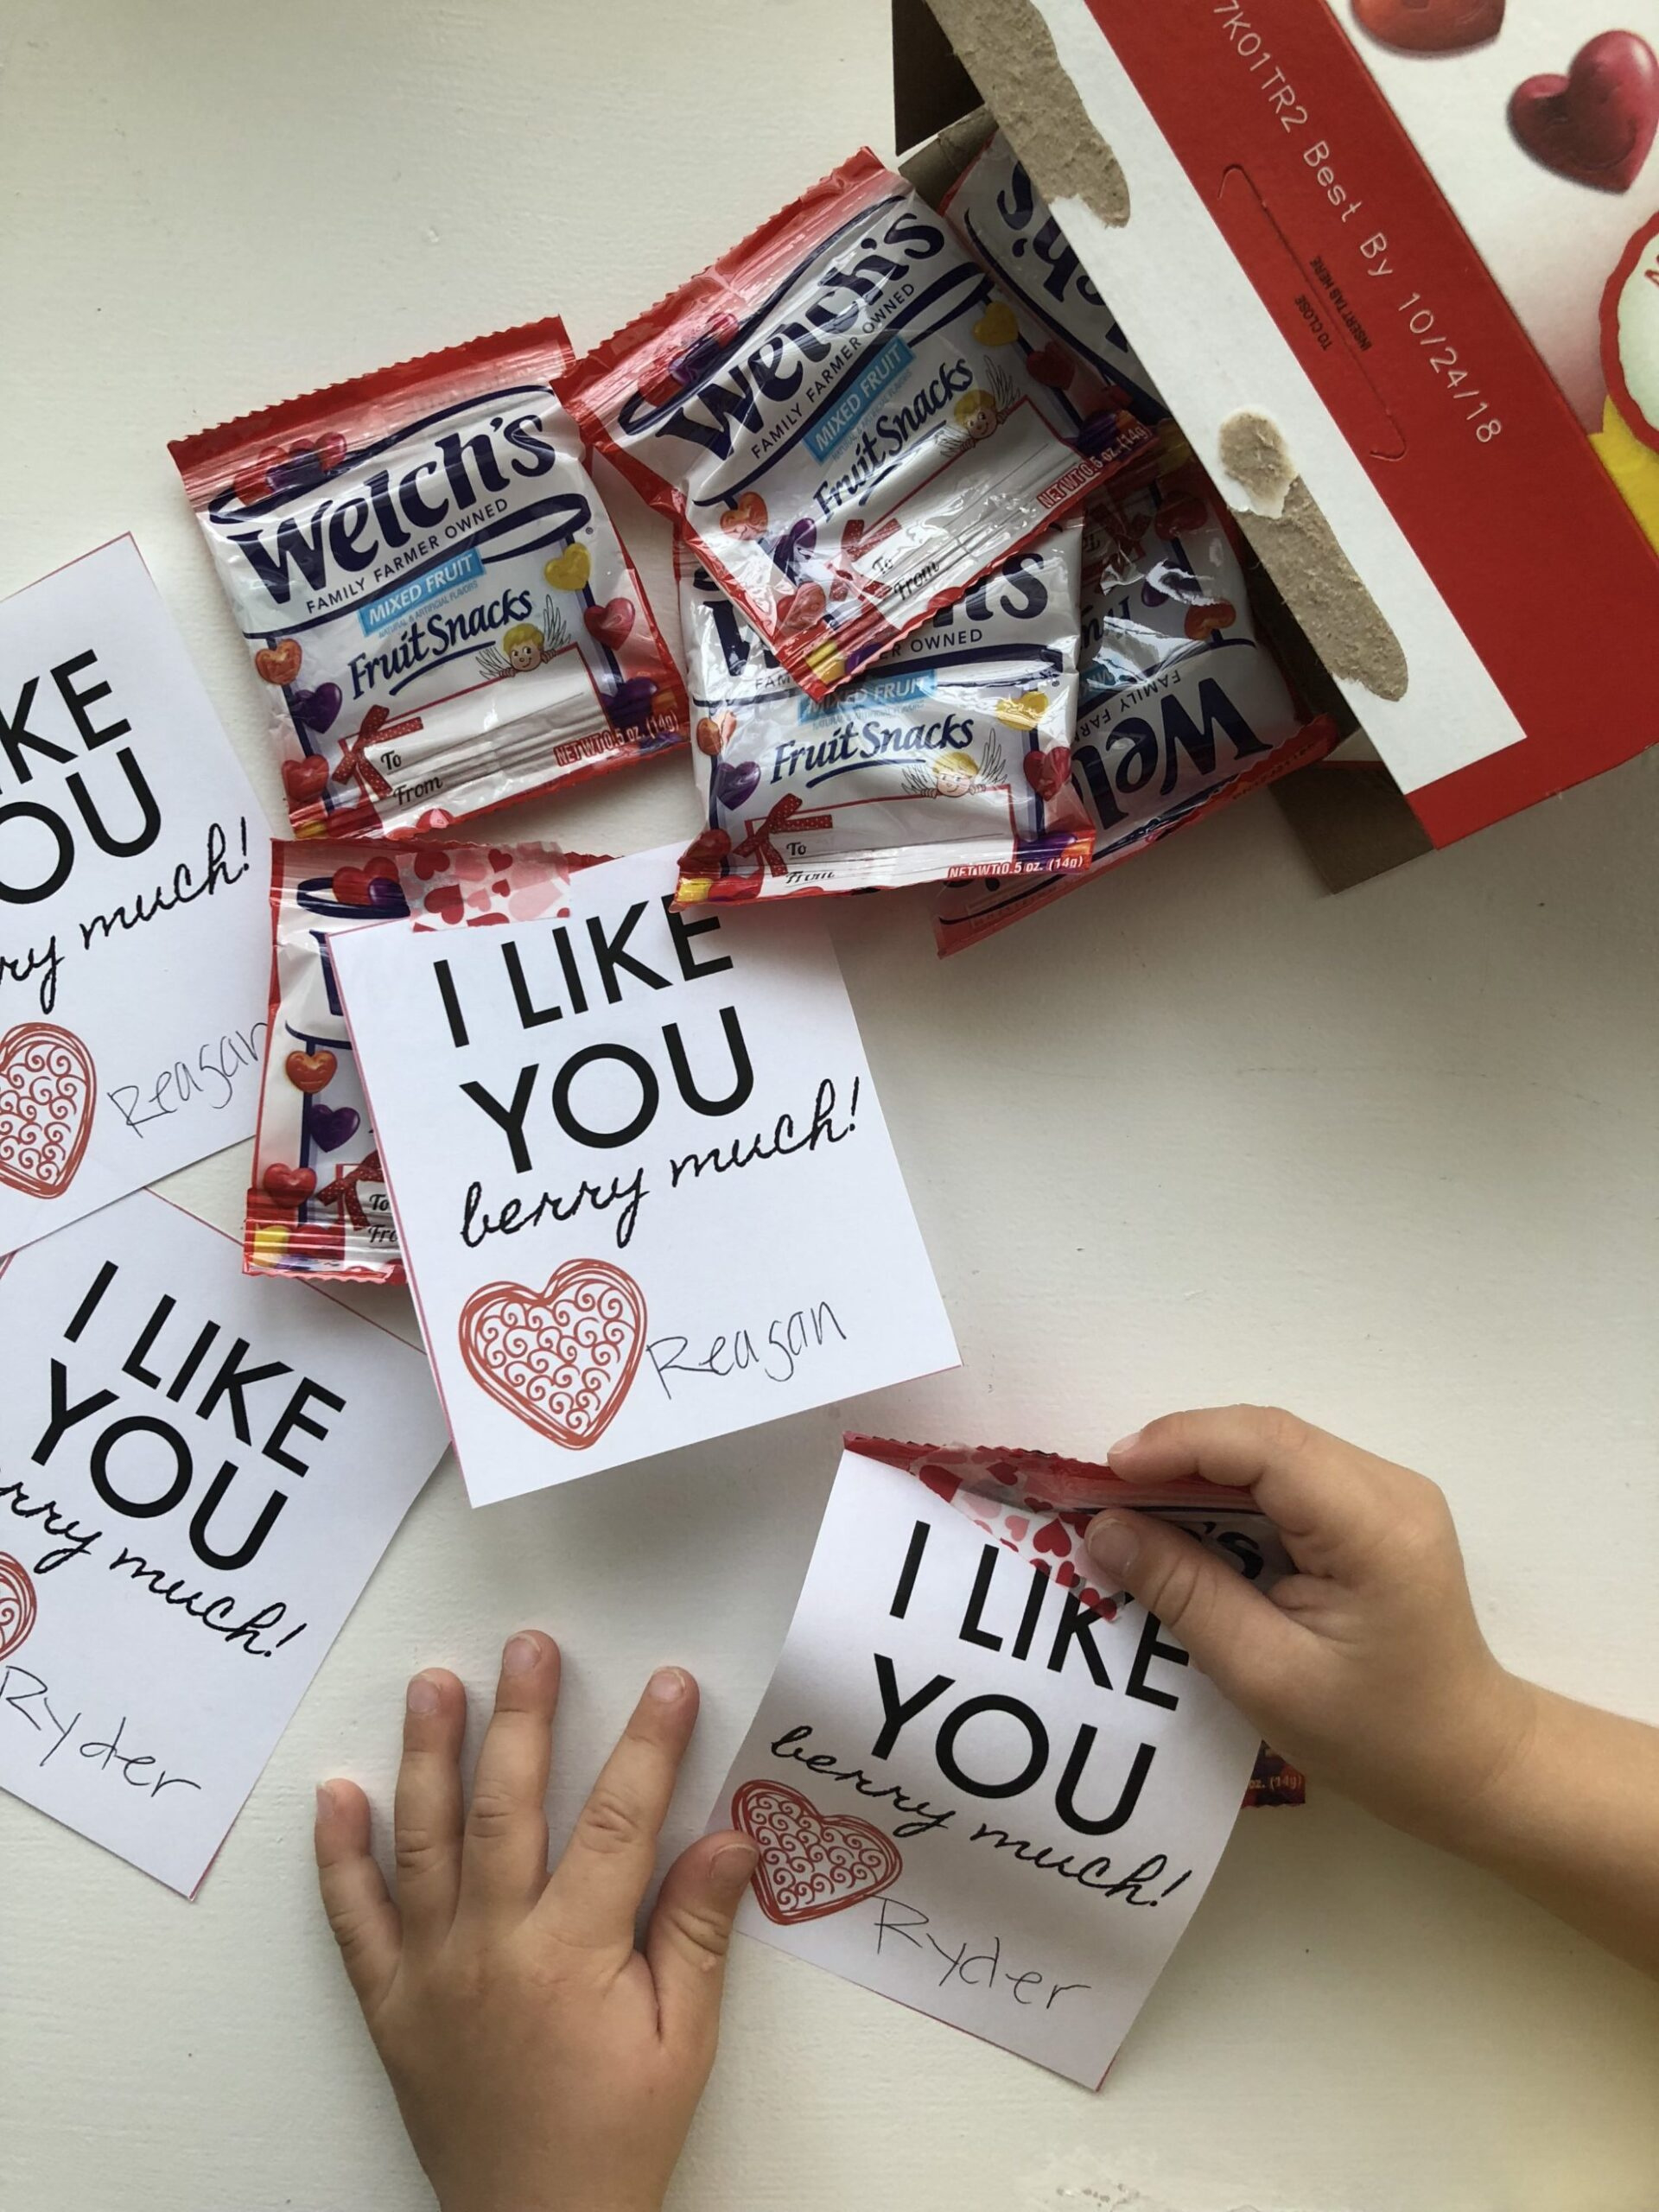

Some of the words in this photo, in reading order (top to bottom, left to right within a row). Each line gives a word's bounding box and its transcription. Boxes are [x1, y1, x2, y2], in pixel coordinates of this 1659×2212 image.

[1213, 0, 1308, 133] 7K01TR2
[1303, 140, 1362, 222] Best
[1360, 233, 1393, 276] By
[1398, 292, 1502, 443] 10/24/18
[1294, 295, 1323, 333] CLOSE
[1310, 256, 1334, 289] HERE
[1329, 287, 1347, 313] TAB
[751, 403, 804, 460] FAMILY
[806, 337, 861, 402] FARMER
[862, 283, 915, 335] OWNED
[1318, 333, 1332, 351] TO
[1342, 311, 1372, 351] INSERT
[815, 394, 861, 450] MIXED
[860, 346, 902, 397] FRUIT
[875, 358, 974, 457] Snacks
[226, 414, 556, 604] Welch's
[1037, 483, 1066, 509] NET
[1078, 455, 1104, 477] 0.5
[1101, 448, 1122, 461] oz.
[306, 577, 366, 614] FAMILY
[373, 535, 440, 582] FARMER
[445, 498, 508, 539] OWNED
[368, 584, 422, 626] MIXED
[424, 556, 474, 594] FRUIT
[893, 559, 941, 602] From
[755, 677, 791, 690] FAM
[911, 628, 982, 654] OWNED
[874, 676, 931, 701] FRUIT
[1120, 670, 1181, 712] FAMILY
[0, 649, 131, 795] KE
[381, 750, 403, 770] To
[555, 743, 582, 766] NET
[581, 734, 604, 757] WT
[603, 728, 625, 750] 0.5
[626, 726, 645, 741] oz.
[646, 710, 679, 739] (14g)
[771, 720, 859, 785] Fruit
[858, 714, 974, 758] Snacks
[0, 747, 162, 905] OU
[393, 775, 443, 805] From
[79, 817, 250, 950] much!
[786, 842, 807, 856] To
[950, 864, 975, 877] NET
[1001, 861, 1021, 874] 0.5
[1025, 862, 1043, 872] oz.
[1049, 856, 1083, 871] (14g)
[433, 959, 470, 1049] I
[501, 893, 734, 1030] LIKE
[459, 1006, 754, 1174] YOU
[369, 1193, 390, 1211] To
[461, 1180, 647, 1249] berry
[671, 1076, 860, 1188] much!
[367, 1224, 398, 1243] Fro
[63, 1260, 119, 1343] I
[121, 1294, 346, 1478] LIKE
[645, 1301, 848, 1399] Reagan
[30, 1357, 288, 1571] YOU
[0, 1481, 102, 1574] rry
[110, 1548, 308, 1658] much!
[889, 1520, 931, 1619] I
[958, 1543, 1190, 1712] LIKE
[0, 1665, 201, 1797] Ryder
[870, 1652, 1157, 1836] YOU
[771, 1726, 956, 1839] berry
[970, 1822, 1192, 1908] much!
[869, 1895, 1091, 2009] Ryder
